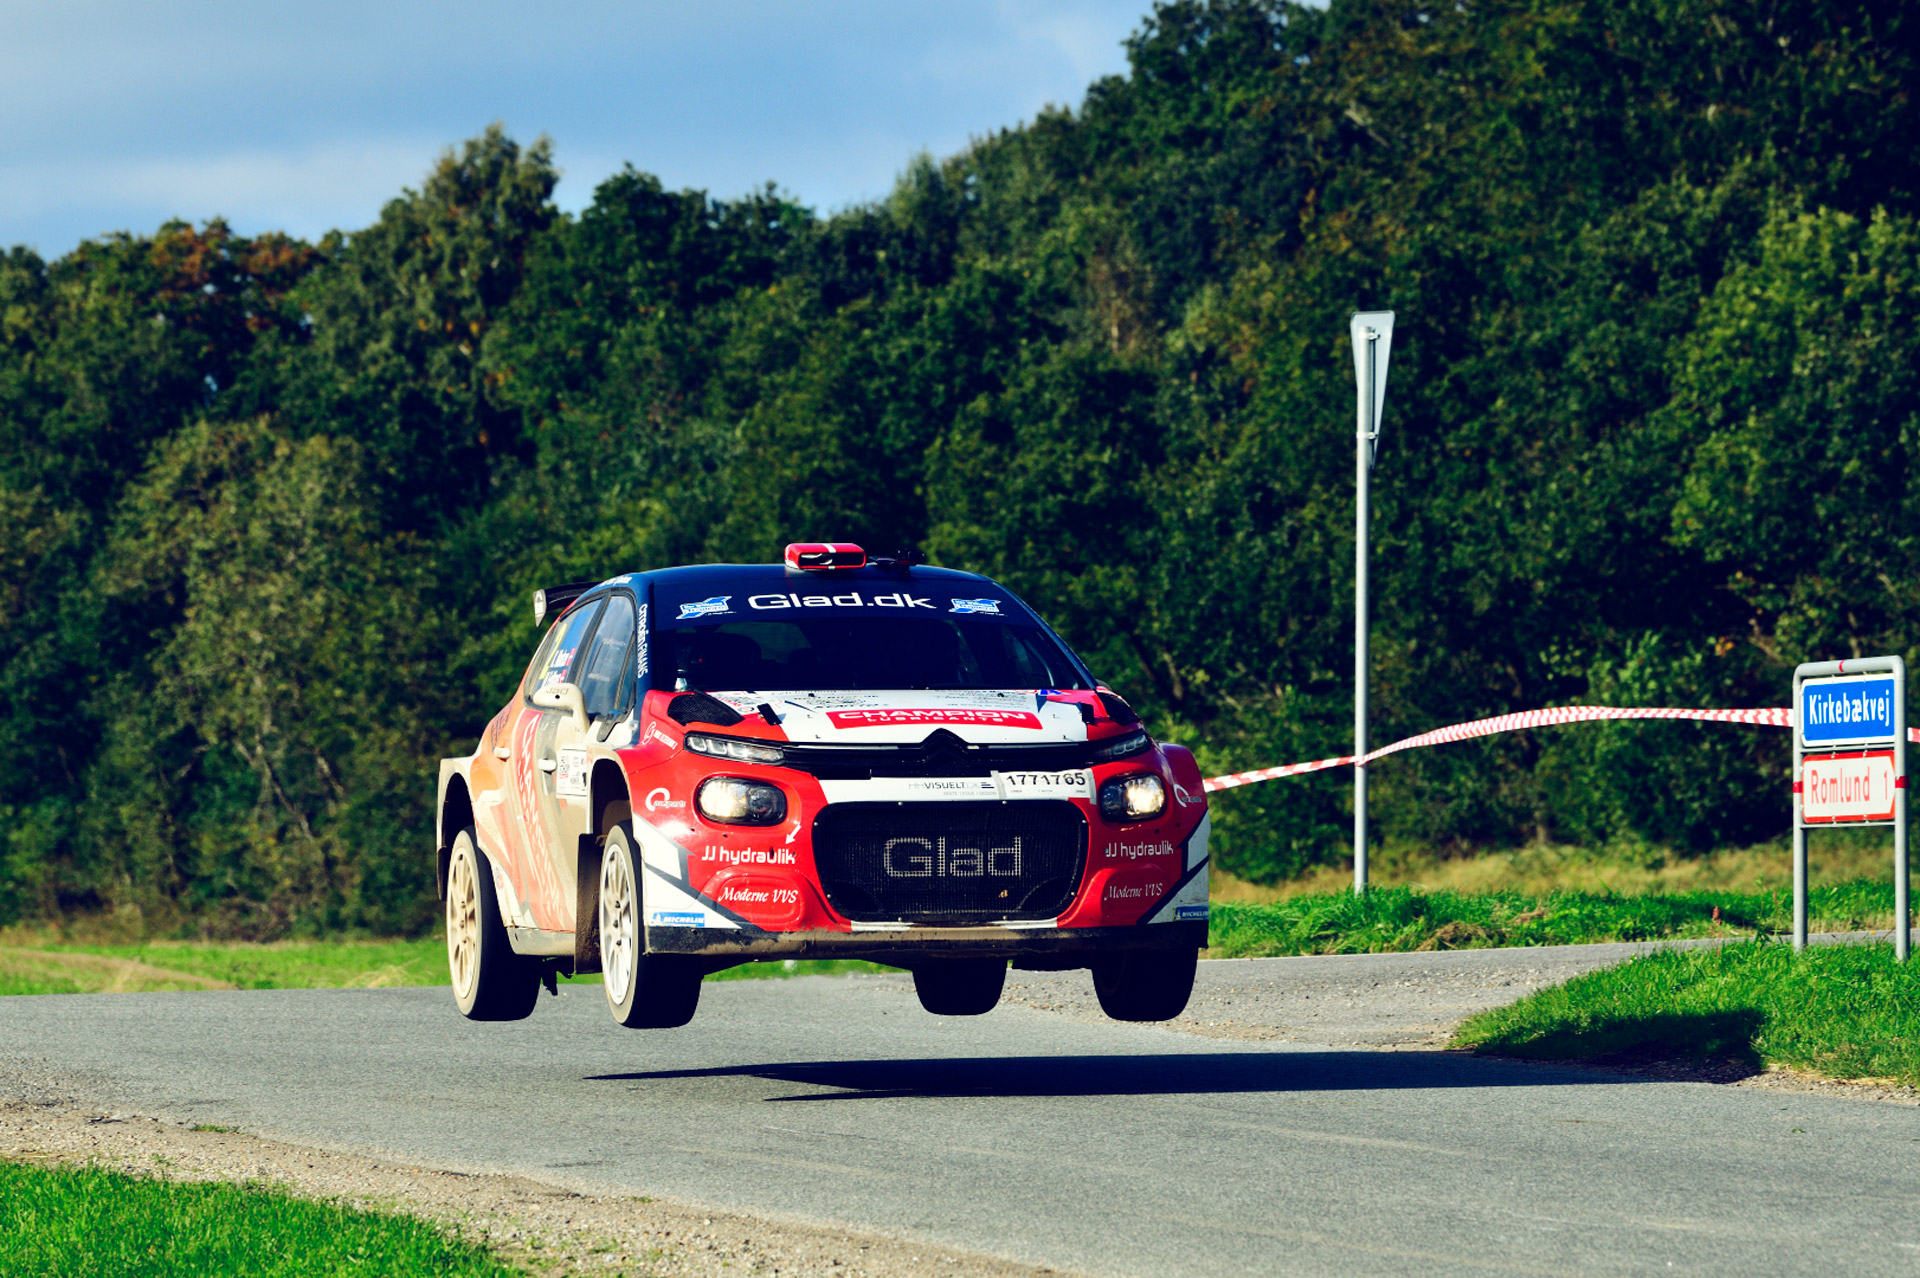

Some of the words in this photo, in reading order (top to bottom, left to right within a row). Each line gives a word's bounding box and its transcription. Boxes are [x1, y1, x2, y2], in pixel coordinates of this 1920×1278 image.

[748, 592, 937, 610] Glad.dk
[838, 710, 1026, 720] CHAMPION
[1809, 689, 1890, 727] Kirkebækvej
[1006, 772, 1086, 786] 1771765
[1811, 766, 1870, 805] Romlund
[1883, 770, 1888, 800] 1
[702, 845, 717, 861] JJ
[719, 846, 796, 866] hydraulik
[884, 836, 1021, 877] Glad
[1105, 842, 1118, 858] JJ
[1120, 840, 1174, 860] hydraulik
[718, 886, 770, 903] Moderne
[772, 888, 799, 904] VVS
[1107, 884, 1142, 899] Moderne
[1145, 882, 1163, 897] VVS
[663, 916, 704, 924] MICHELIN
